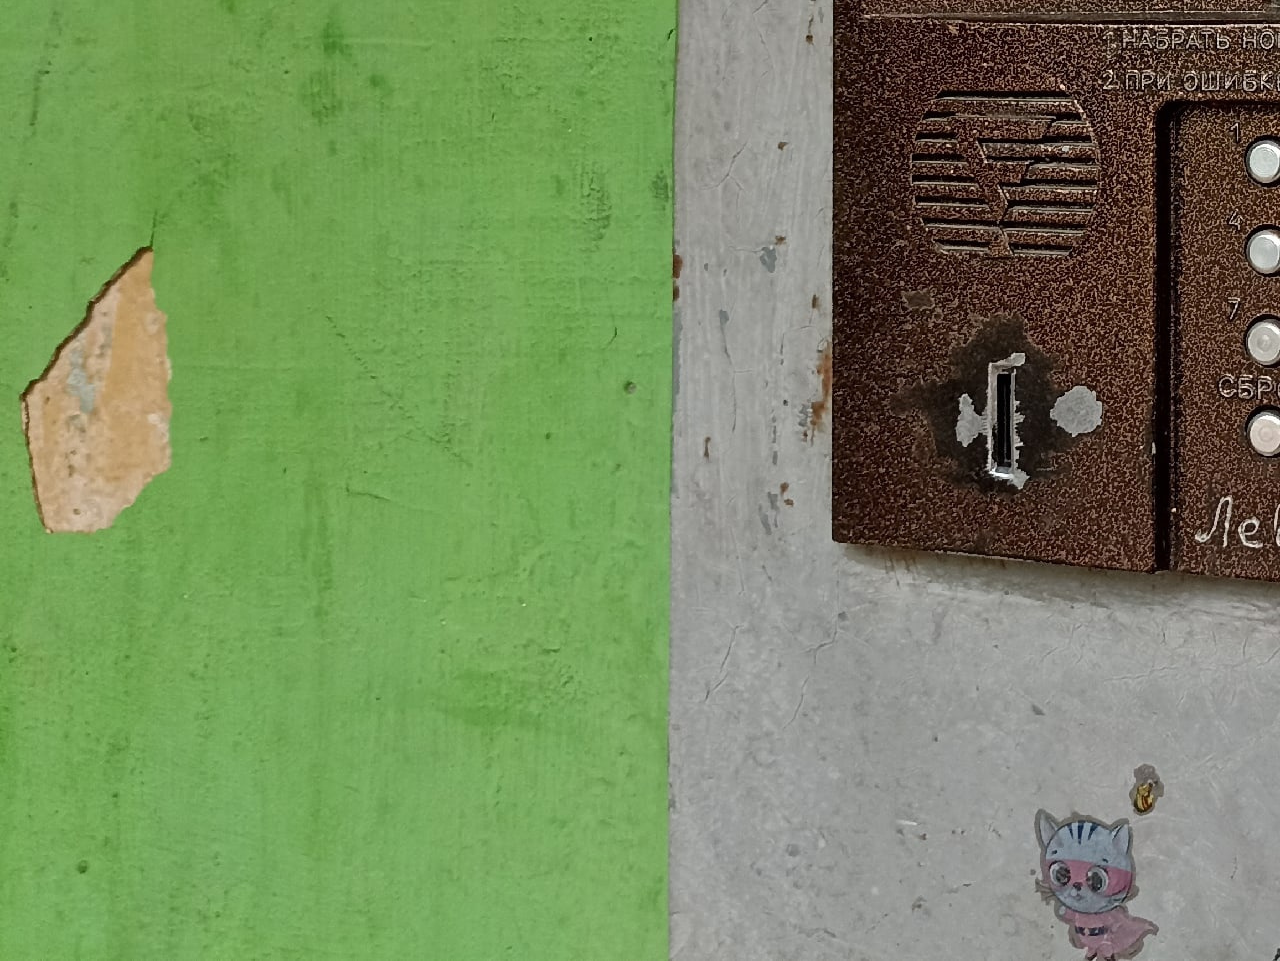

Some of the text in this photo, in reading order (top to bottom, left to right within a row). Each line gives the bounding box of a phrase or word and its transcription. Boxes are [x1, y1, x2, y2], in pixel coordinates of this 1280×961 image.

[1121, 29, 1230, 50] НАБРАТЬ
[1125, 71, 1172, 91] ПРИ
[1228, 297, 1241, 321] 7
